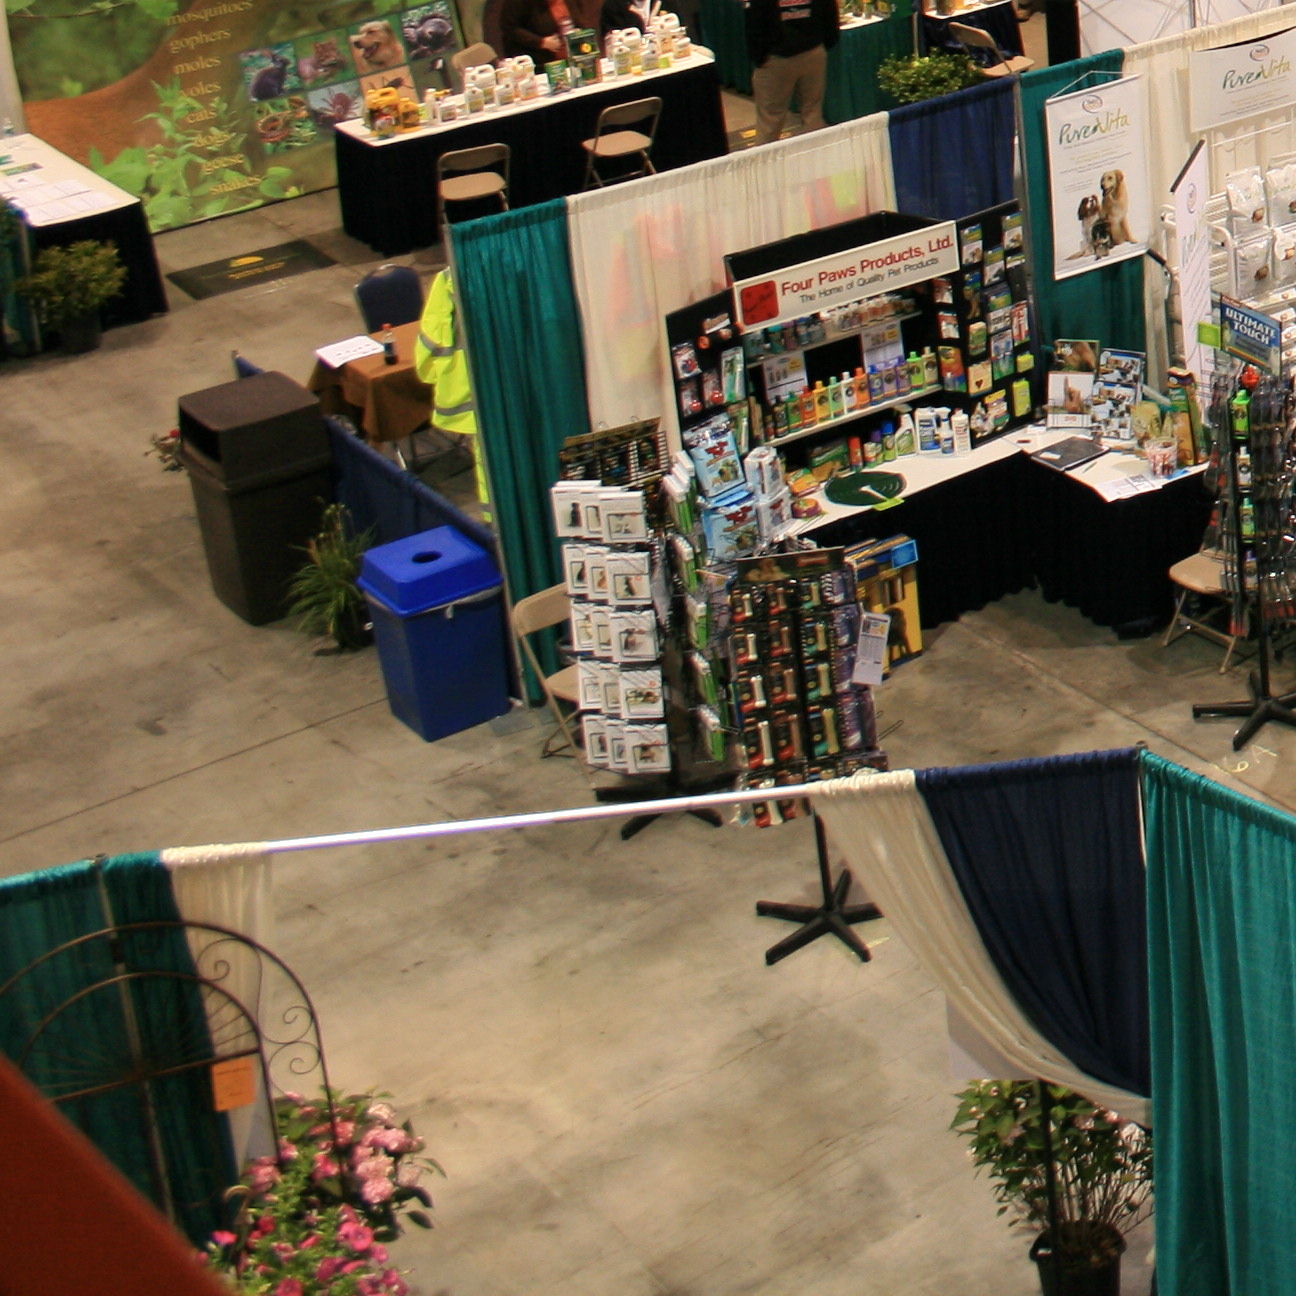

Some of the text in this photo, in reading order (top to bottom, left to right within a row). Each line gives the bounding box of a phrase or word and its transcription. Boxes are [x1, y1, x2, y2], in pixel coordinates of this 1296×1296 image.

[167, 0, 253, 25] mosquitoes
[169, 28, 231, 53] gophers
[174, 56, 221, 74] moles
[180, 81, 221, 97] voles
[187, 108, 216, 123] cats
[202, 154, 244, 175] geese
[781, 235, 954, 296] Four Paws Products, Ltd.
[800, 257, 939, 303] The Home of Quality Pet Products
[1226, 307, 1276, 338] ULTIMATE
[1233, 321, 1269, 344] TOUCH
